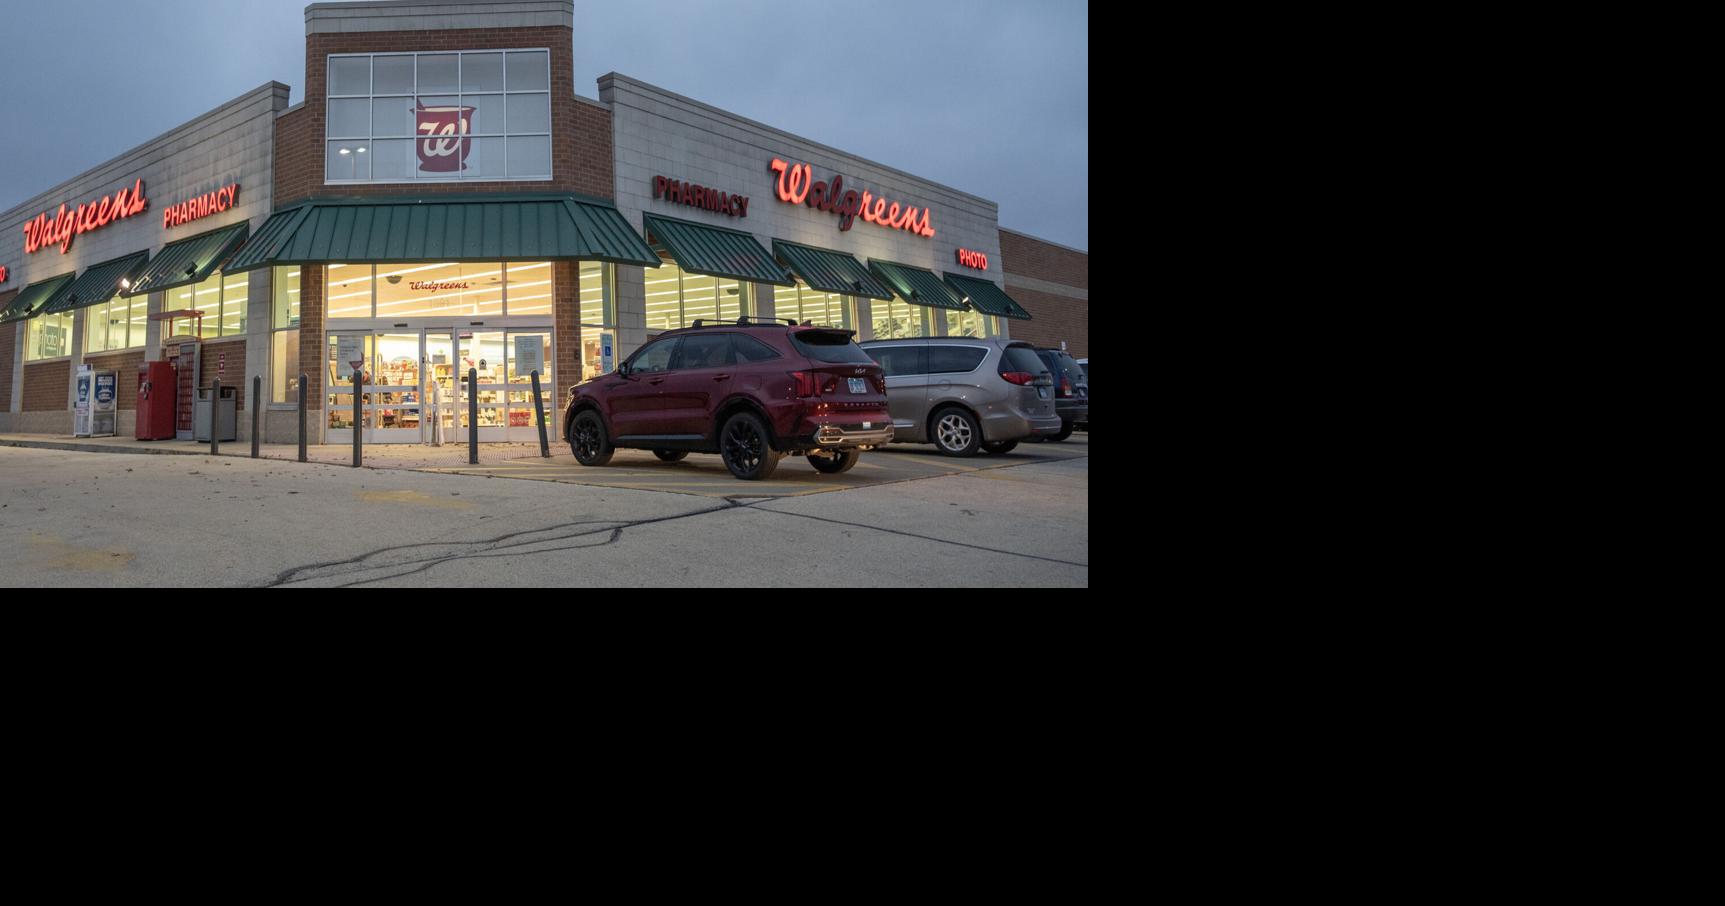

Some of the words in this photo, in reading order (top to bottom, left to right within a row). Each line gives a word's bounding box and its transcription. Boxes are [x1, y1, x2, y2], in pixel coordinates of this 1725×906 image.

[23, 176, 147, 255] Walgreens
[163, 183, 239, 230] PHARMACY
[654, 174, 750, 218] PHARMACY
[773, 157, 937, 237] Walgreens
[958, 247, 988, 270] PHOTO
[409, 281, 469, 293] Walgreens
